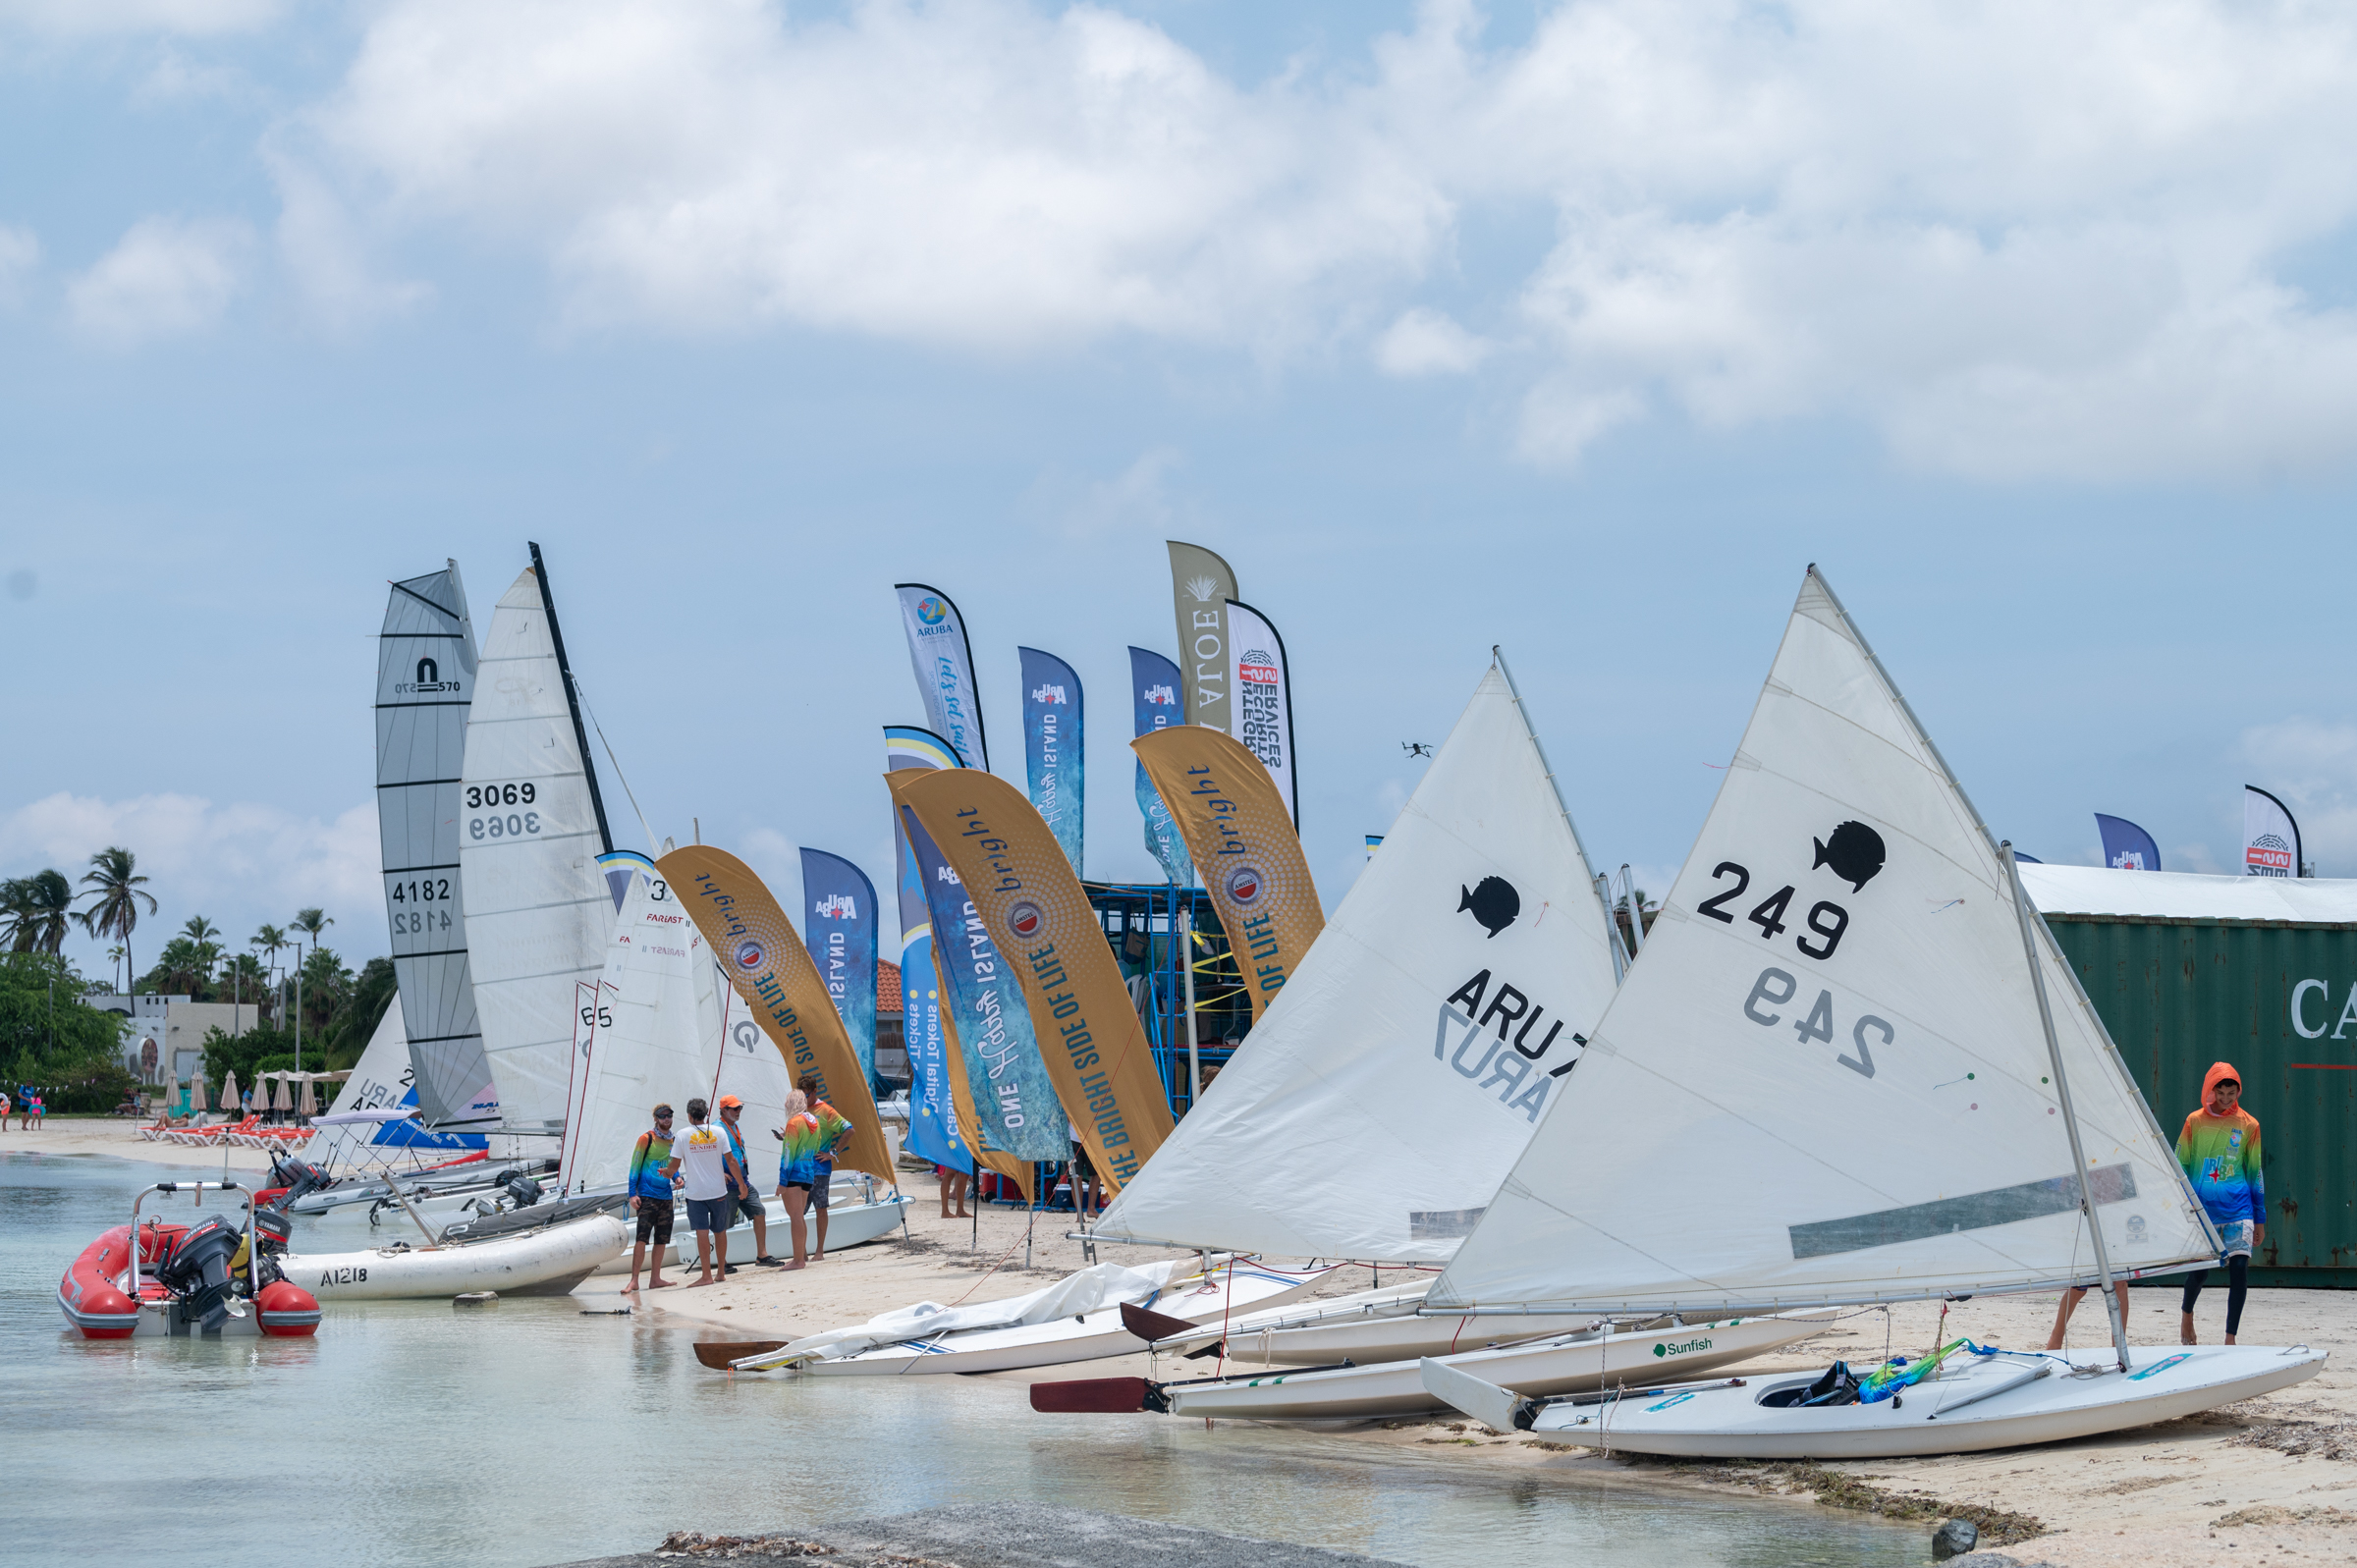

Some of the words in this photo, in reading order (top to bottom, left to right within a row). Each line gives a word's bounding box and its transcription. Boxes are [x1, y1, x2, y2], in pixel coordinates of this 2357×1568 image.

[917, 624, 954, 637] ARUBA
[438, 680, 461, 692] 570
[938, 657, 958, 694] Let's
[945, 695, 964, 720] set
[950, 723, 969, 756] sail
[466, 783, 536, 809] 3069
[1186, 763, 1245, 855] bright
[956, 806, 1021, 893] bright
[393, 879, 450, 904] 4182
[1234, 879, 1253, 890] AMSTEL
[694, 872, 746, 937] bright
[1015, 912, 1033, 924] AMSTEL
[1696, 861, 1849, 960] 249
[1243, 912, 1280, 959] LIFE
[1028, 944, 1068, 991] LIFE
[1257, 958, 1287, 992] OF
[754, 972, 786, 1008] LIFE
[772, 1007, 797, 1028] OF
[1047, 992, 1079, 1019] OF
[787, 1026, 814, 1064] SIDE
[1060, 1018, 1100, 1070] SIDE
[1079, 1071, 1130, 1150] BRIGHT
[2200, 1155, 2234, 1183] ARUBA
[190, 1220, 214, 1236] YAMAHA
[264, 1221, 281, 1233] YAMAHA
[320, 1268, 367, 1287] A1218
[1668, 1337, 1713, 1356] Sunfish
